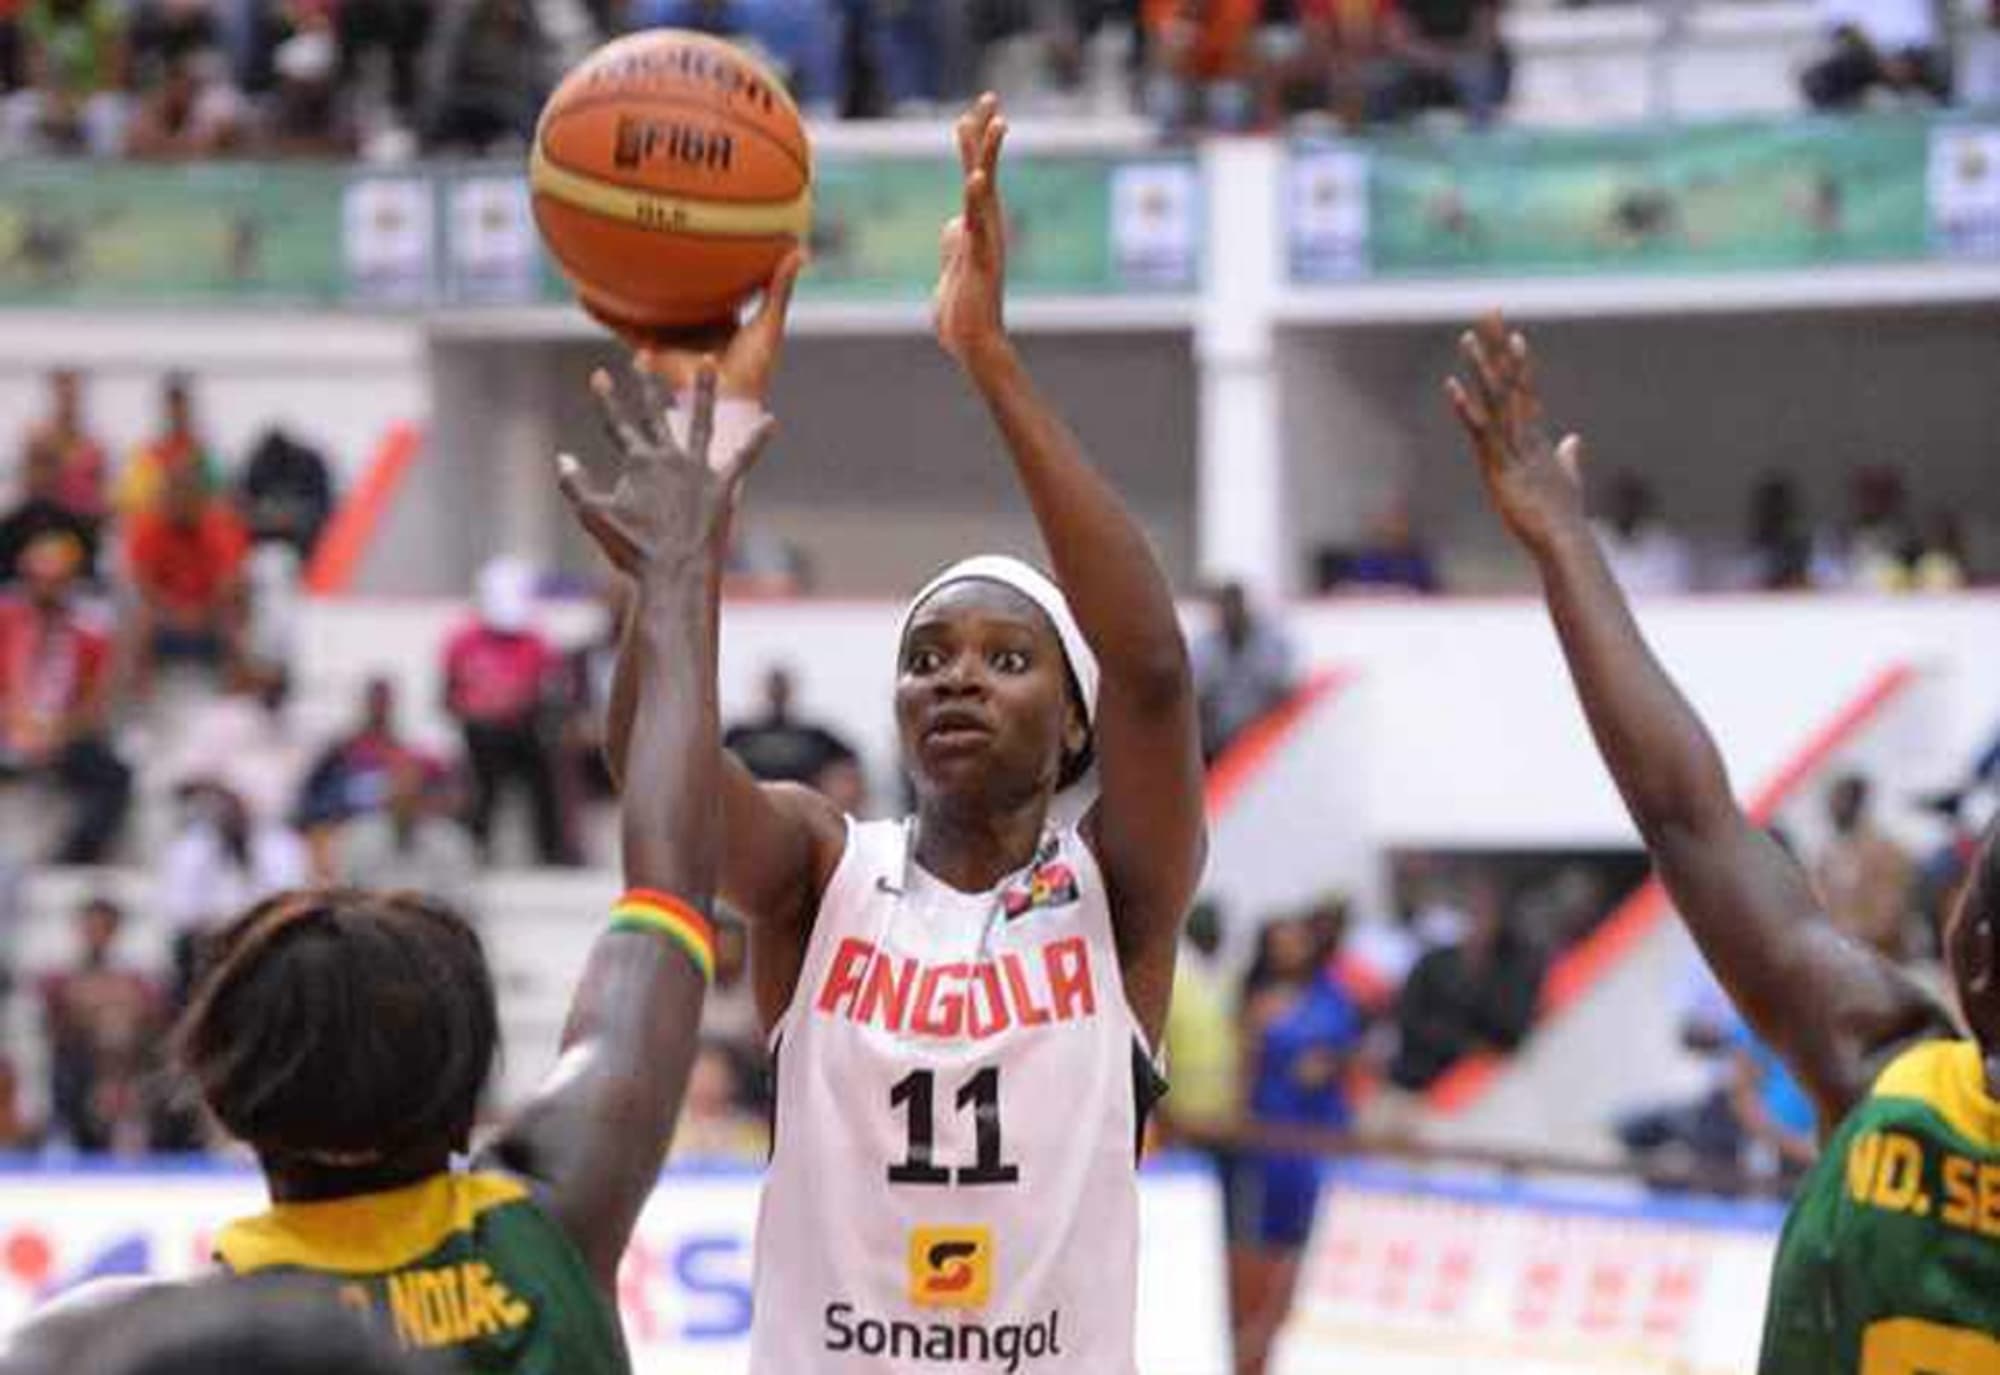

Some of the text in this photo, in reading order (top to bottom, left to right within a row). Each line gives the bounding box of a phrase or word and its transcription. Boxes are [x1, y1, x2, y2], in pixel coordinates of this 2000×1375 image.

[814, 936, 1097, 1042] ANGOLA
[888, 1066, 1019, 1186] 11
[825, 1303, 1062, 1374] Sonangol
